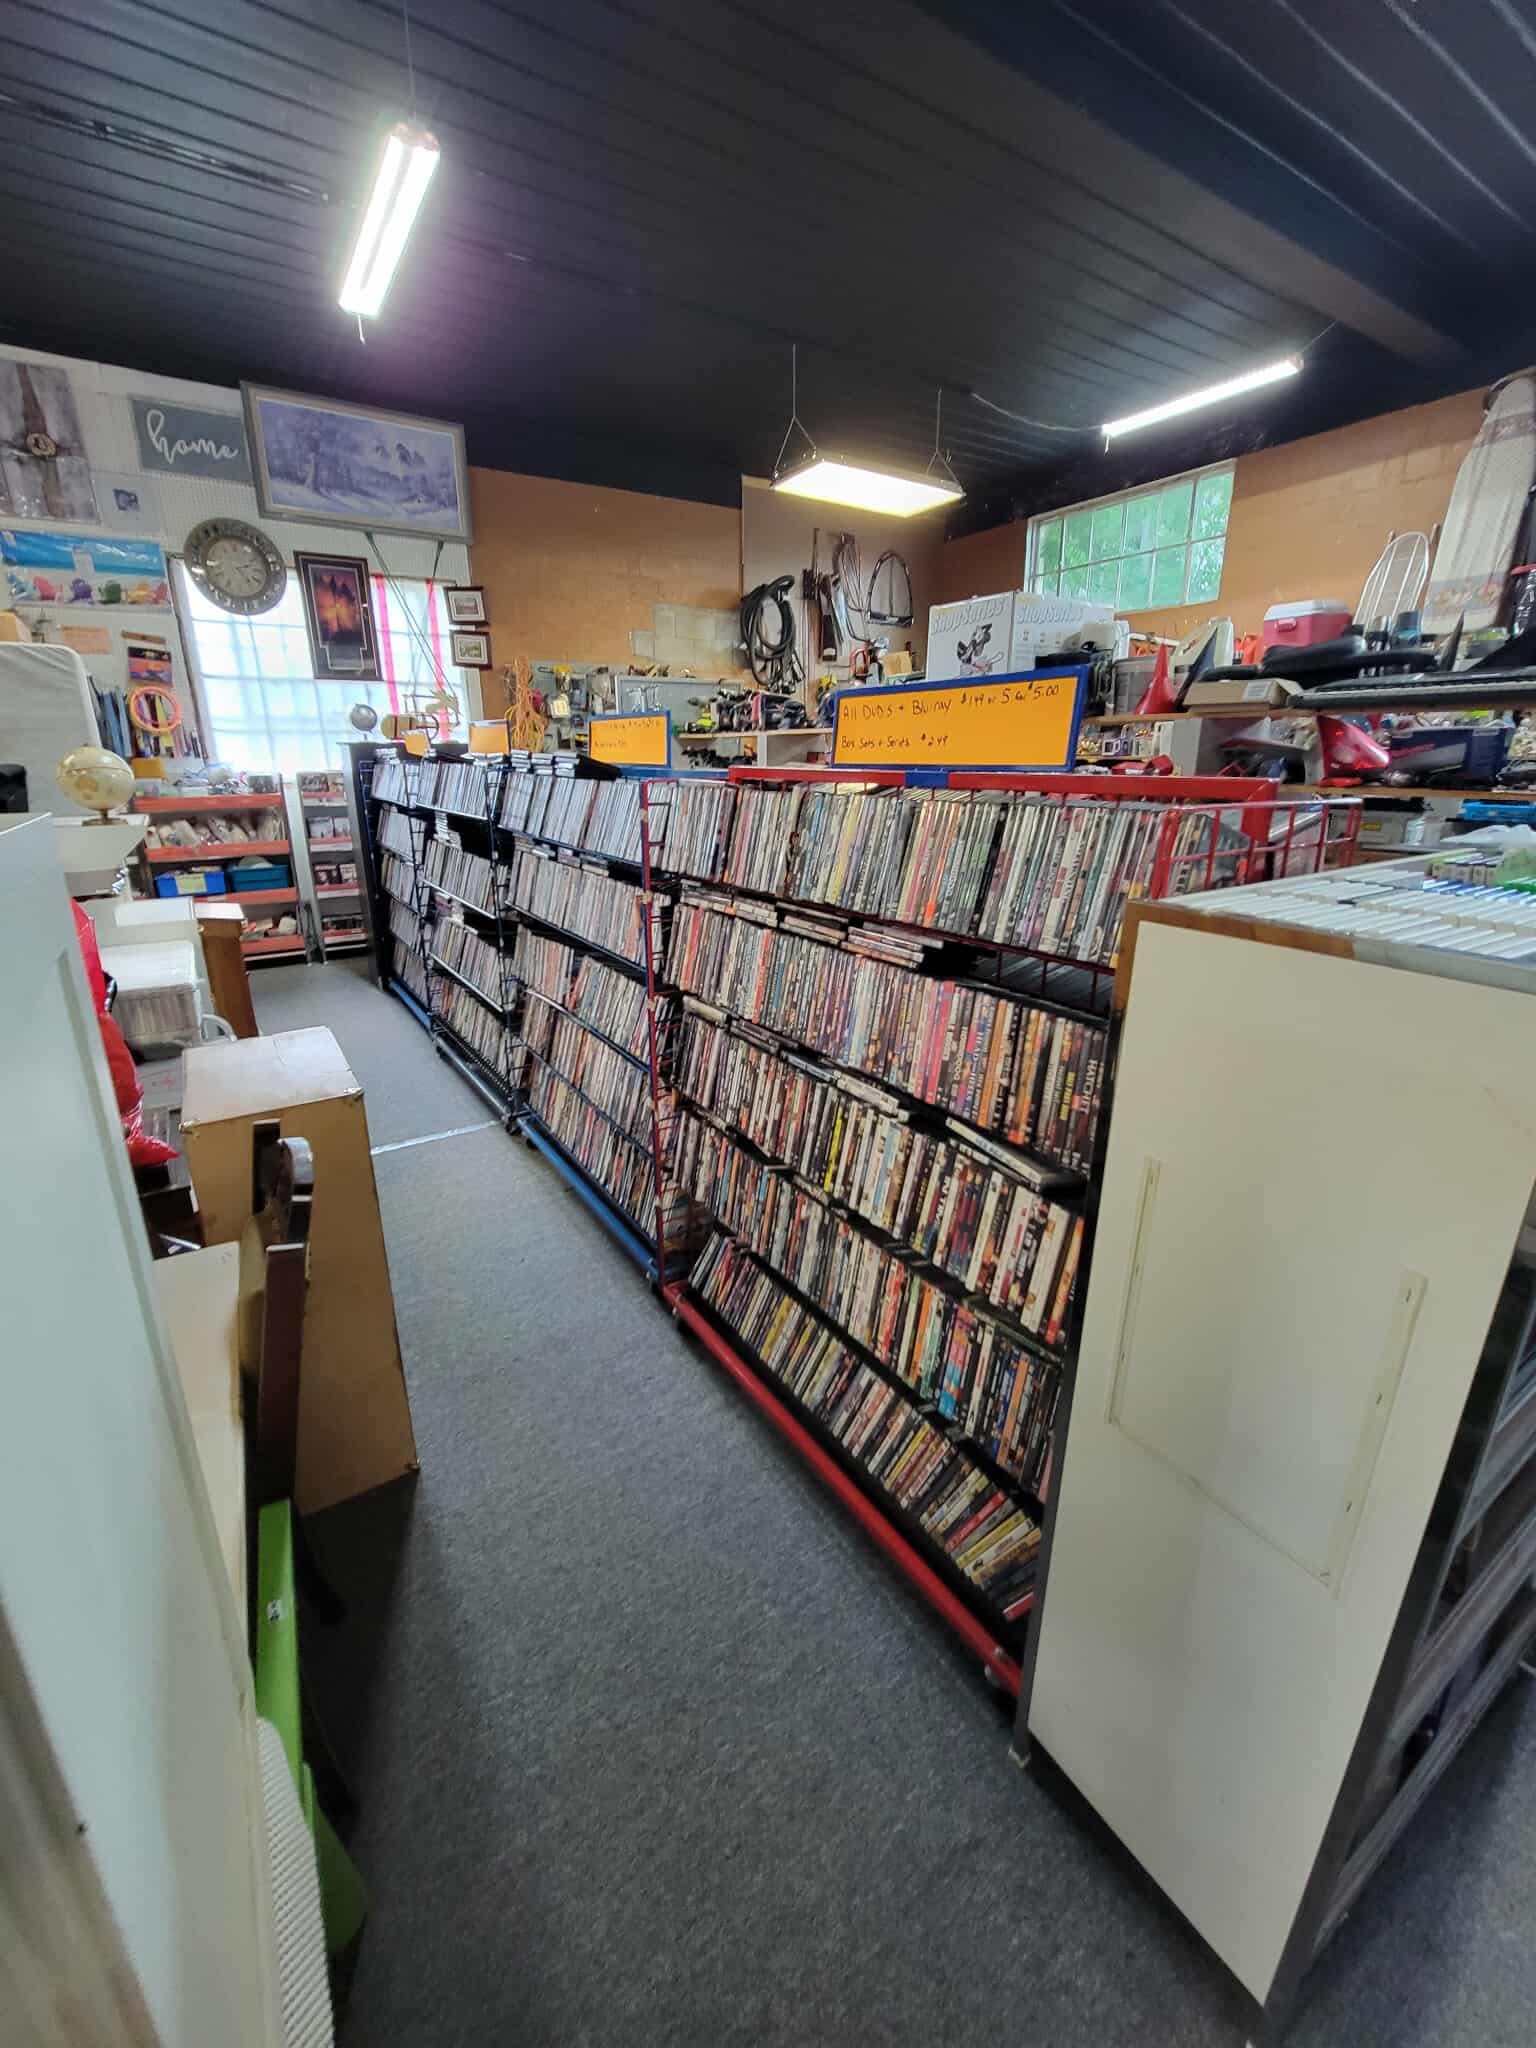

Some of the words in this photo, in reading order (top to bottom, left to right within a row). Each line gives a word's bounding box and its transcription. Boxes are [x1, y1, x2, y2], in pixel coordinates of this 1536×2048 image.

[146, 408, 240, 465] home
[842, 704, 857, 721] All
[1080, 1058, 1097, 1114] HATCHET
